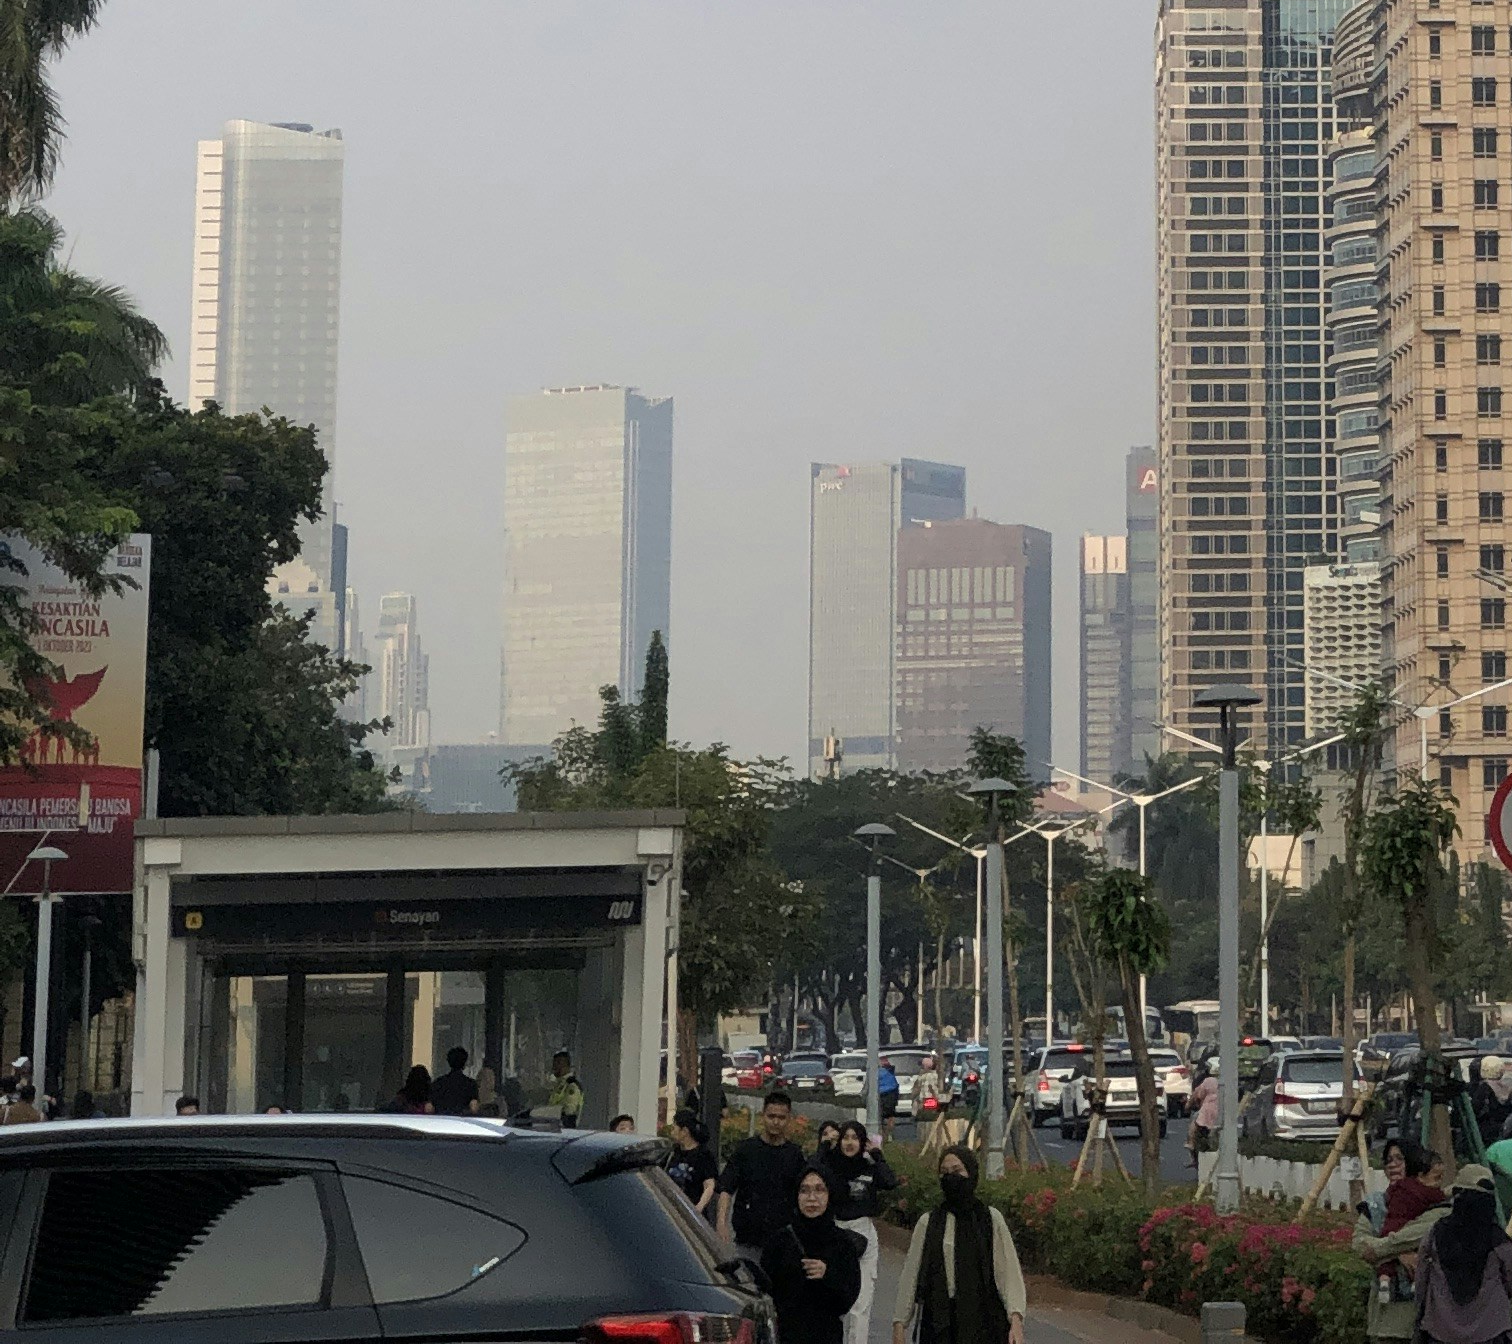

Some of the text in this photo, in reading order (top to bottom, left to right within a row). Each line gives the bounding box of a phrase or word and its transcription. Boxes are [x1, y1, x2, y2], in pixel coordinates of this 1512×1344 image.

[32, 601, 101, 617] KESAKTIAN
[95, 797, 131, 816] BANGSA
[389, 909, 440, 926] Senayan
